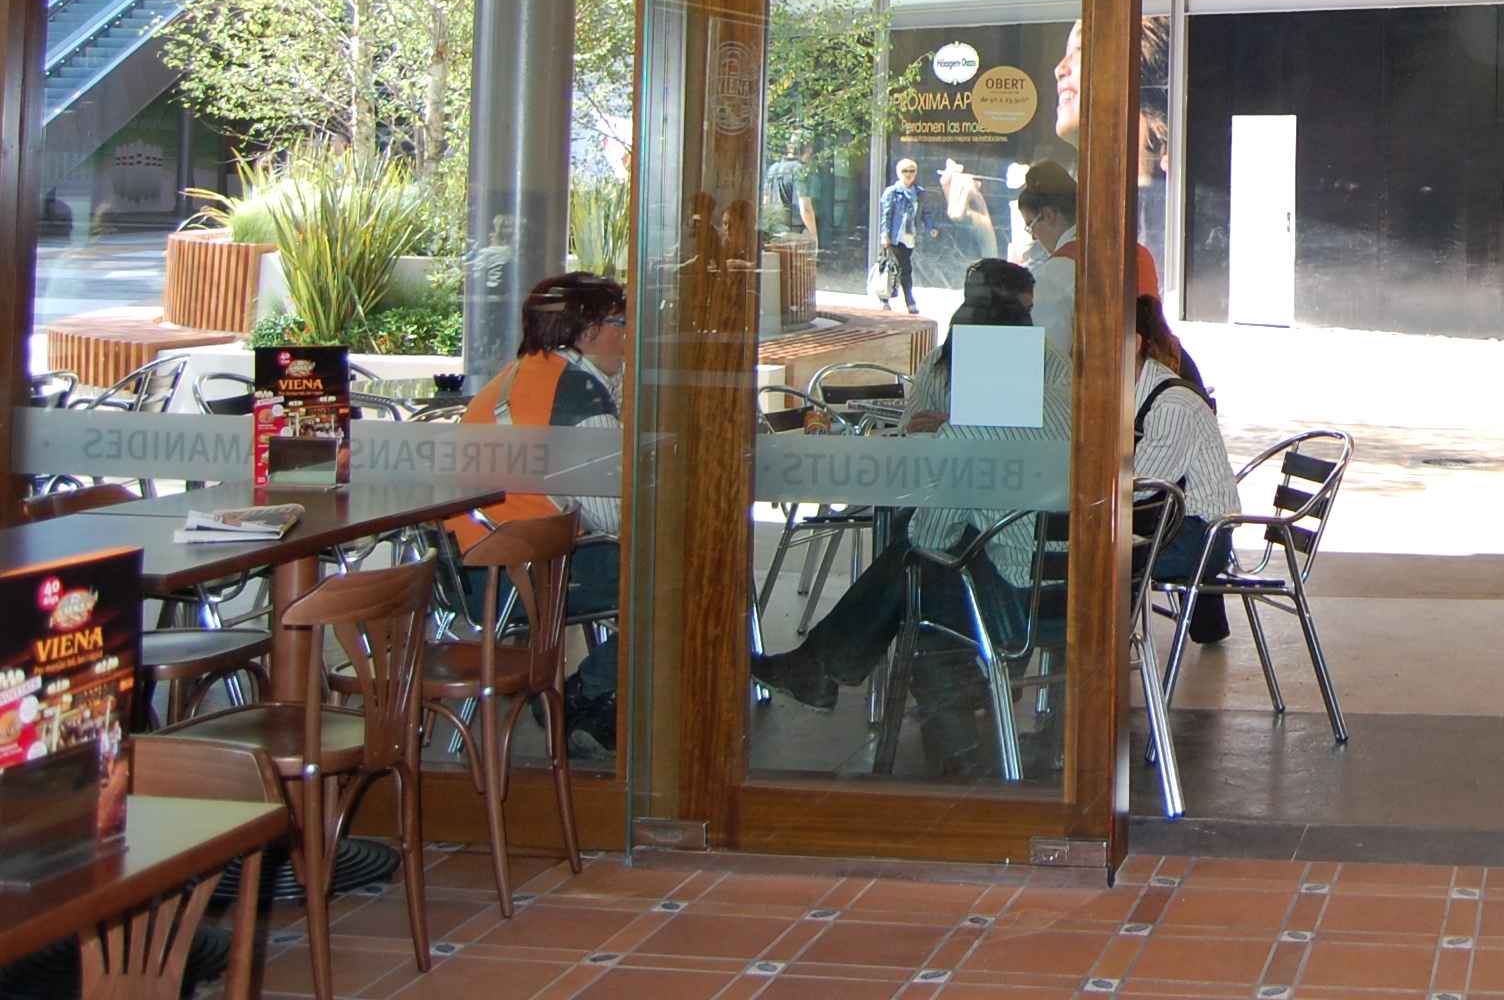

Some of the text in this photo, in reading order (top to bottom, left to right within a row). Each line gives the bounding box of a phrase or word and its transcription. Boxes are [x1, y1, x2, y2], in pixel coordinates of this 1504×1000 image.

[985, 78, 1025, 90] OBERT
[279, 379, 324, 391] VIENA
[36, 626, 104, 662] VIENA
